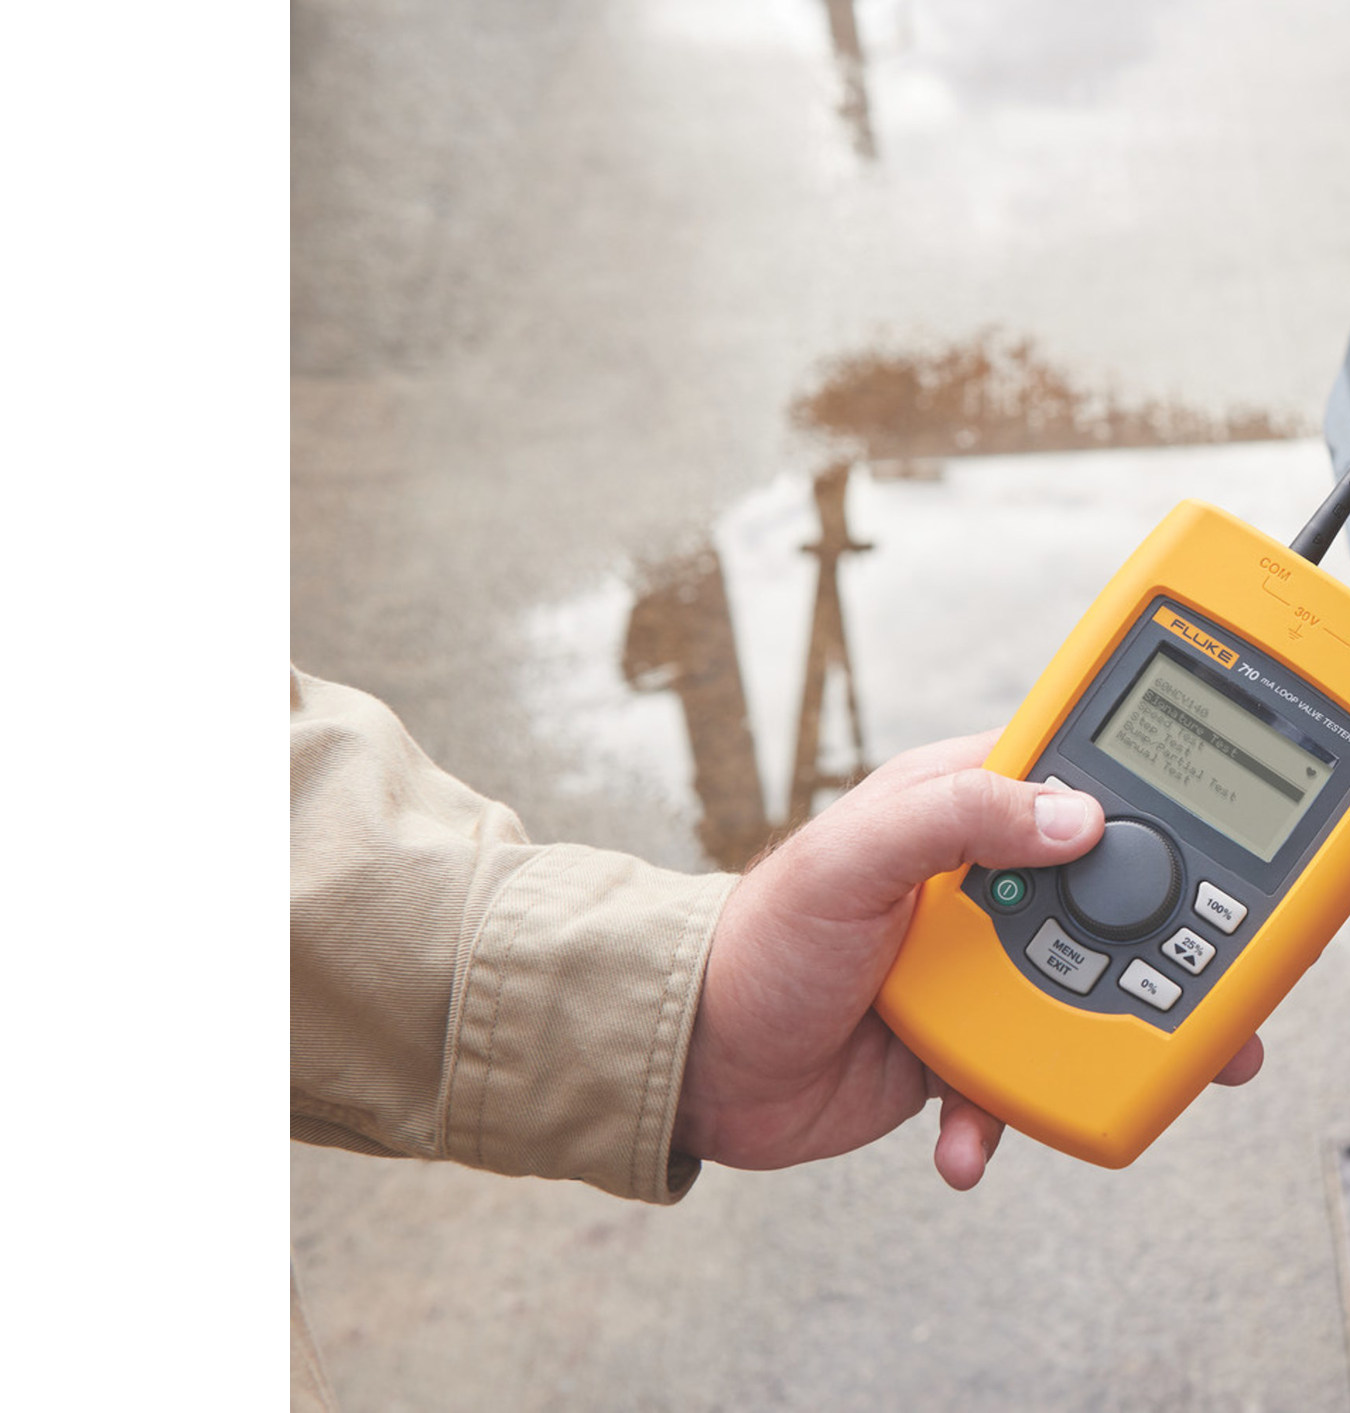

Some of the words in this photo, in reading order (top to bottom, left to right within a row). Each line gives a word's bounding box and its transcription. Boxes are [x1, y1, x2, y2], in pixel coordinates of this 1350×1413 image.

[1260, 557, 1292, 581] COM
[1294, 606, 1321, 626] 30V
[1170, 618, 1234, 665] FLUKE
[1237, 662, 1260, 682] 710
[1260, 676, 1276, 691] mA
[1274, 685, 1299, 704] LOOP
[1298, 700, 1324, 722] VALVE
[1129, 711, 1158, 735] Step
[1164, 733, 1192, 758] Test
[1137, 700, 1173, 729] Speed
[1177, 726, 1206, 752] Test
[1142, 689, 1205, 736] Signature
[1211, 734, 1241, 759] Test
[1115, 730, 1158, 764] Manual
[1162, 761, 1192, 786] Test
[1122, 722, 1204, 779] Bump/Partial
[1208, 777, 1238, 803] Test
[1206, 898, 1233, 921] 100%
[1052, 938, 1086, 965] MENU
[1182, 937, 1204, 957] 25%
[1046, 955, 1073, 977] EXIT
[1140, 977, 1158, 996] 0%
